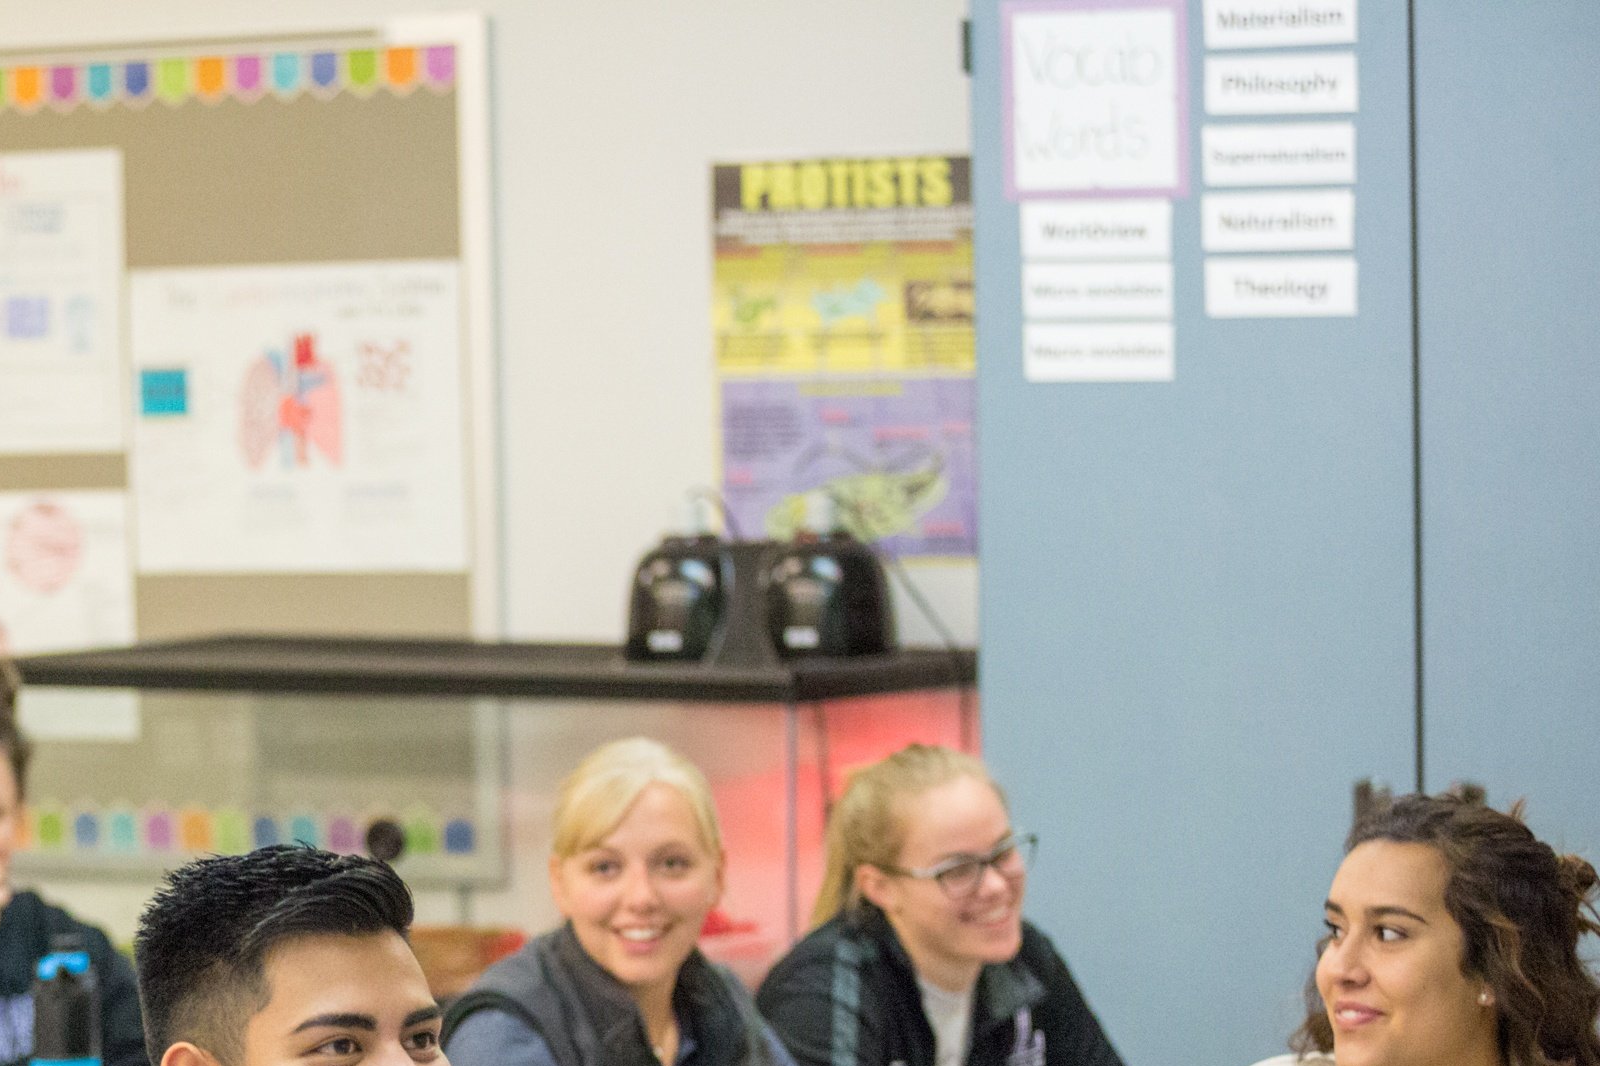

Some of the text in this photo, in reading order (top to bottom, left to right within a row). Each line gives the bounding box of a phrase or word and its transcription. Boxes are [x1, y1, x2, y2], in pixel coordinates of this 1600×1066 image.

[1216, 8, 1344, 31] Materialism
[1221, 71, 1338, 95] Philosophy
[742, 158, 952, 210] PROTISTS
[1218, 212, 1337, 233] Naturalism
[1232, 277, 1330, 303] Theology
